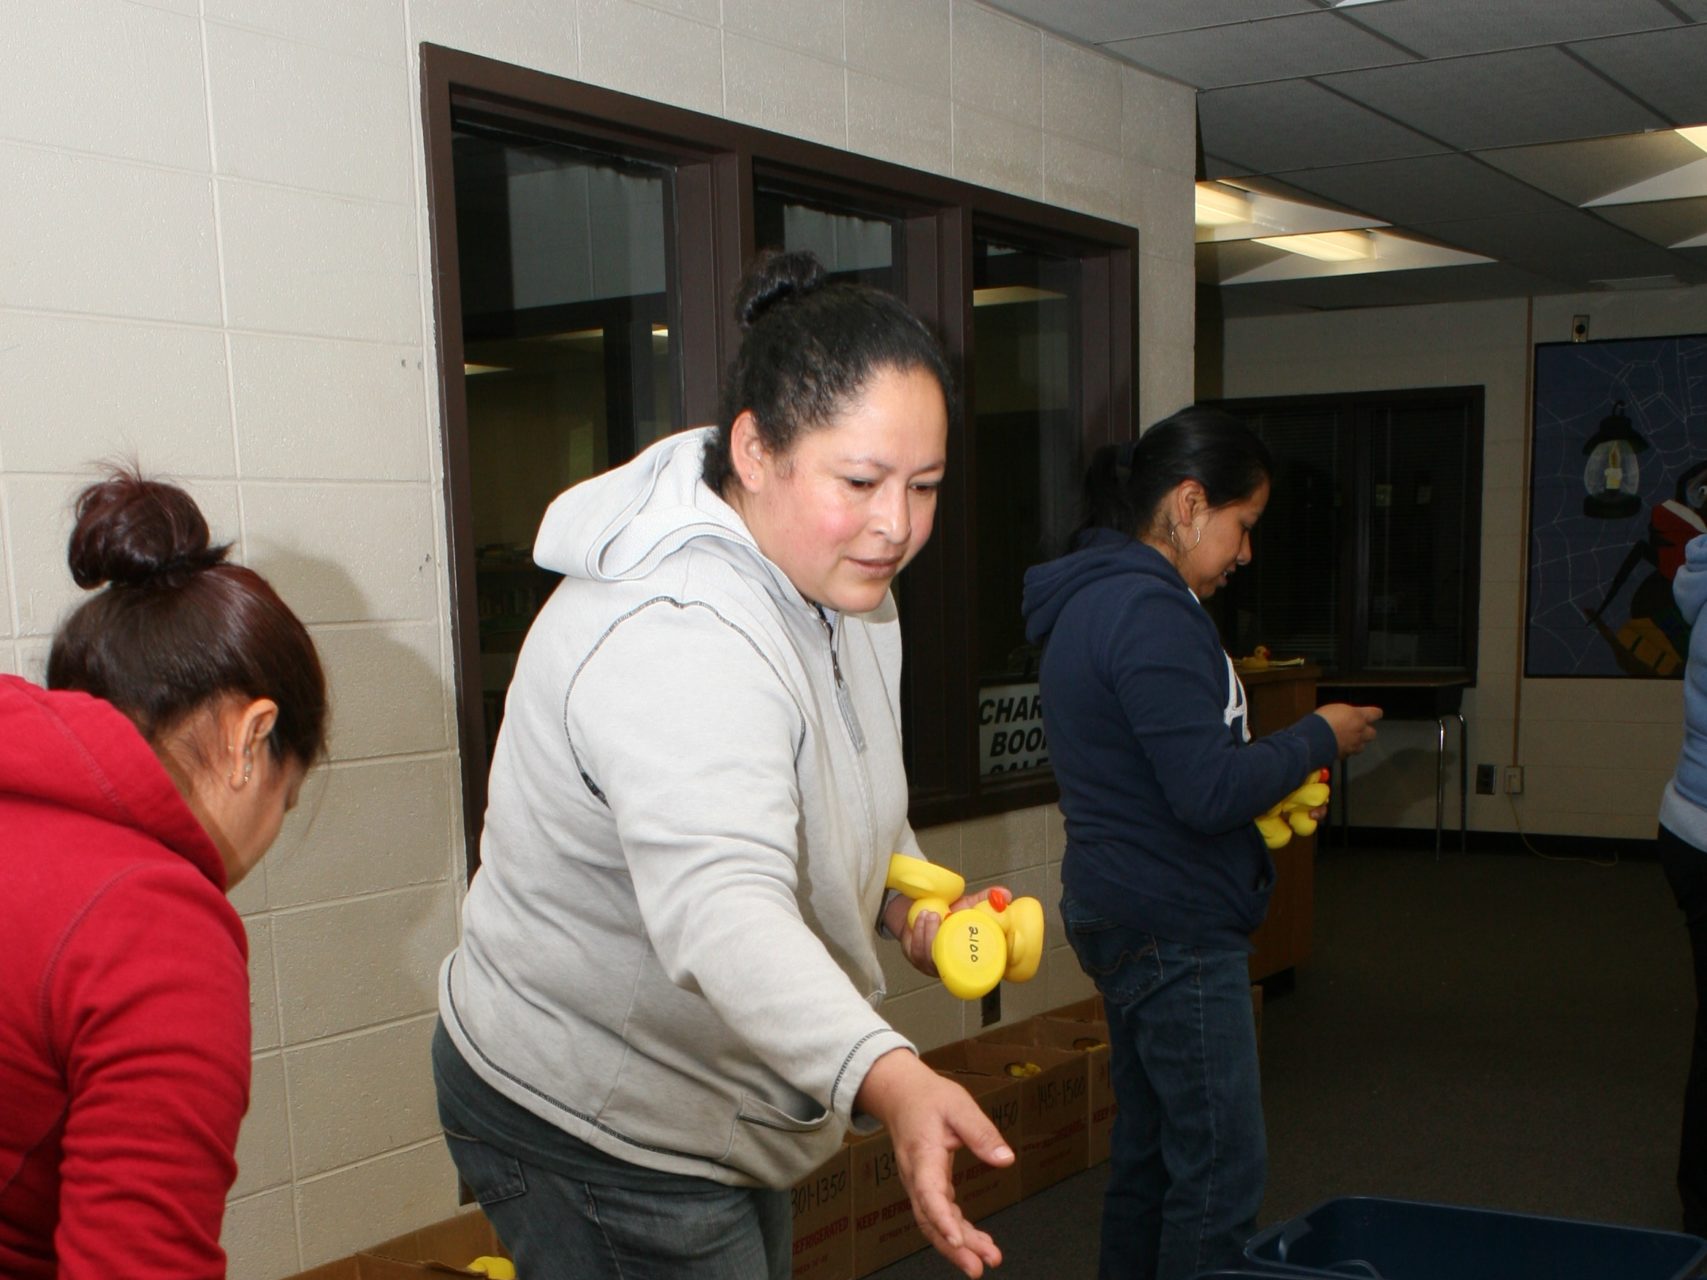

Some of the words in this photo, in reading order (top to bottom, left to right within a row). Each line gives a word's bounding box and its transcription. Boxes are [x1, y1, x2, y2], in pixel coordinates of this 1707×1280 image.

[990, 727, 1047, 757] BOO
[968, 926, 979, 963] 2100
[855, 1210, 880, 1232] KEEP
